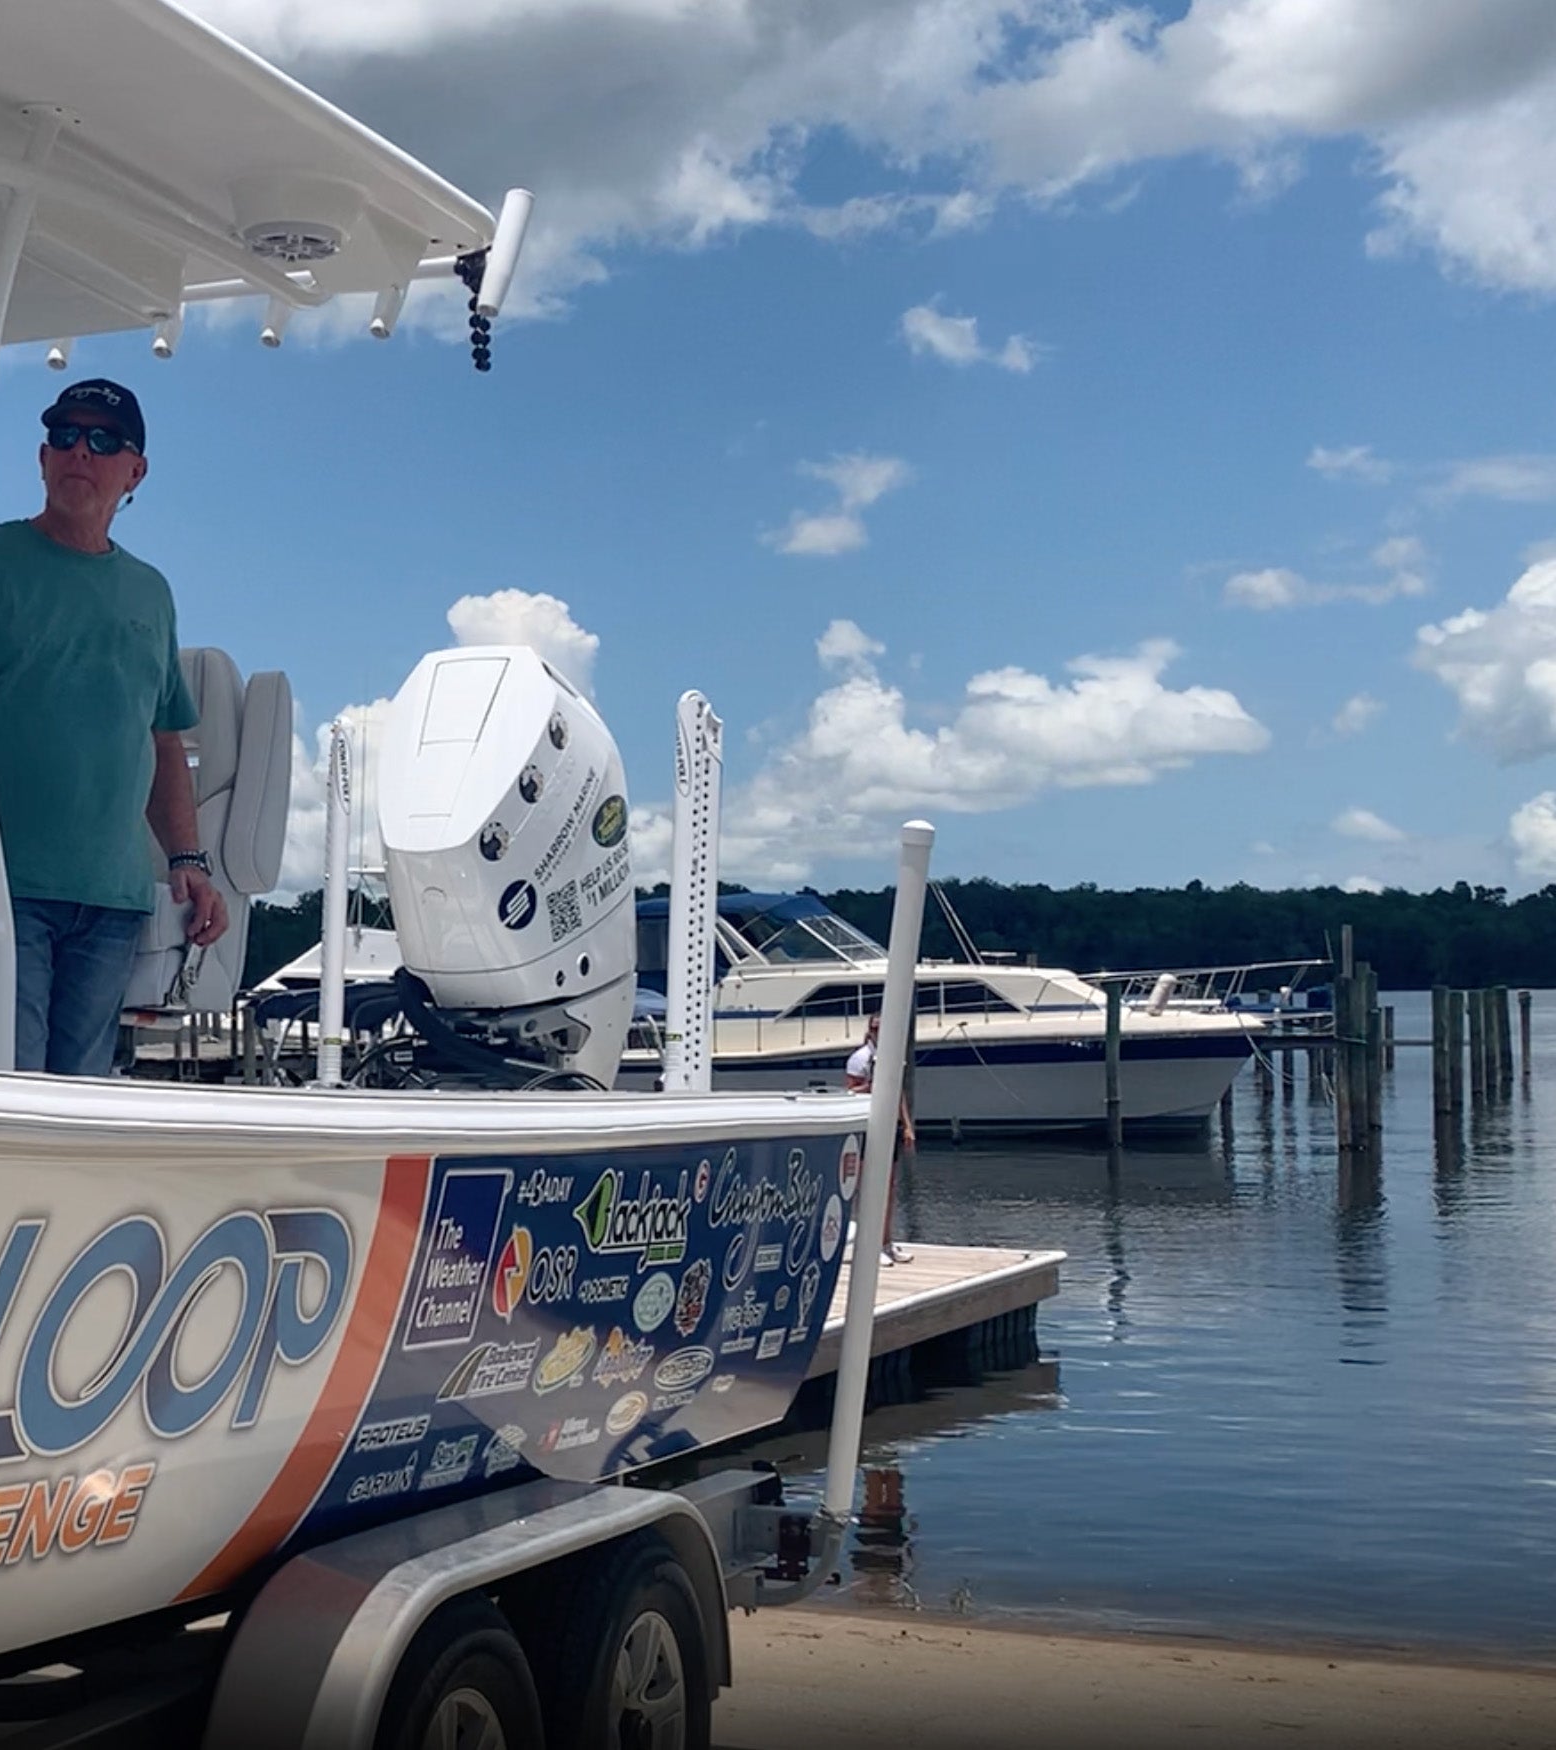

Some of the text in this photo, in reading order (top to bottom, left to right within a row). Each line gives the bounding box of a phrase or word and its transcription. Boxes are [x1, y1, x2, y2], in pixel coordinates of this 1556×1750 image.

[436, 1217, 464, 1250] The
[426, 1254, 485, 1289] Weather
[527, 1245, 578, 1304] OSR
[415, 1292, 476, 1329] Channel
[357, 1417, 429, 1451] PROTEUS
[348, 1468, 413, 1502] GARMIN
